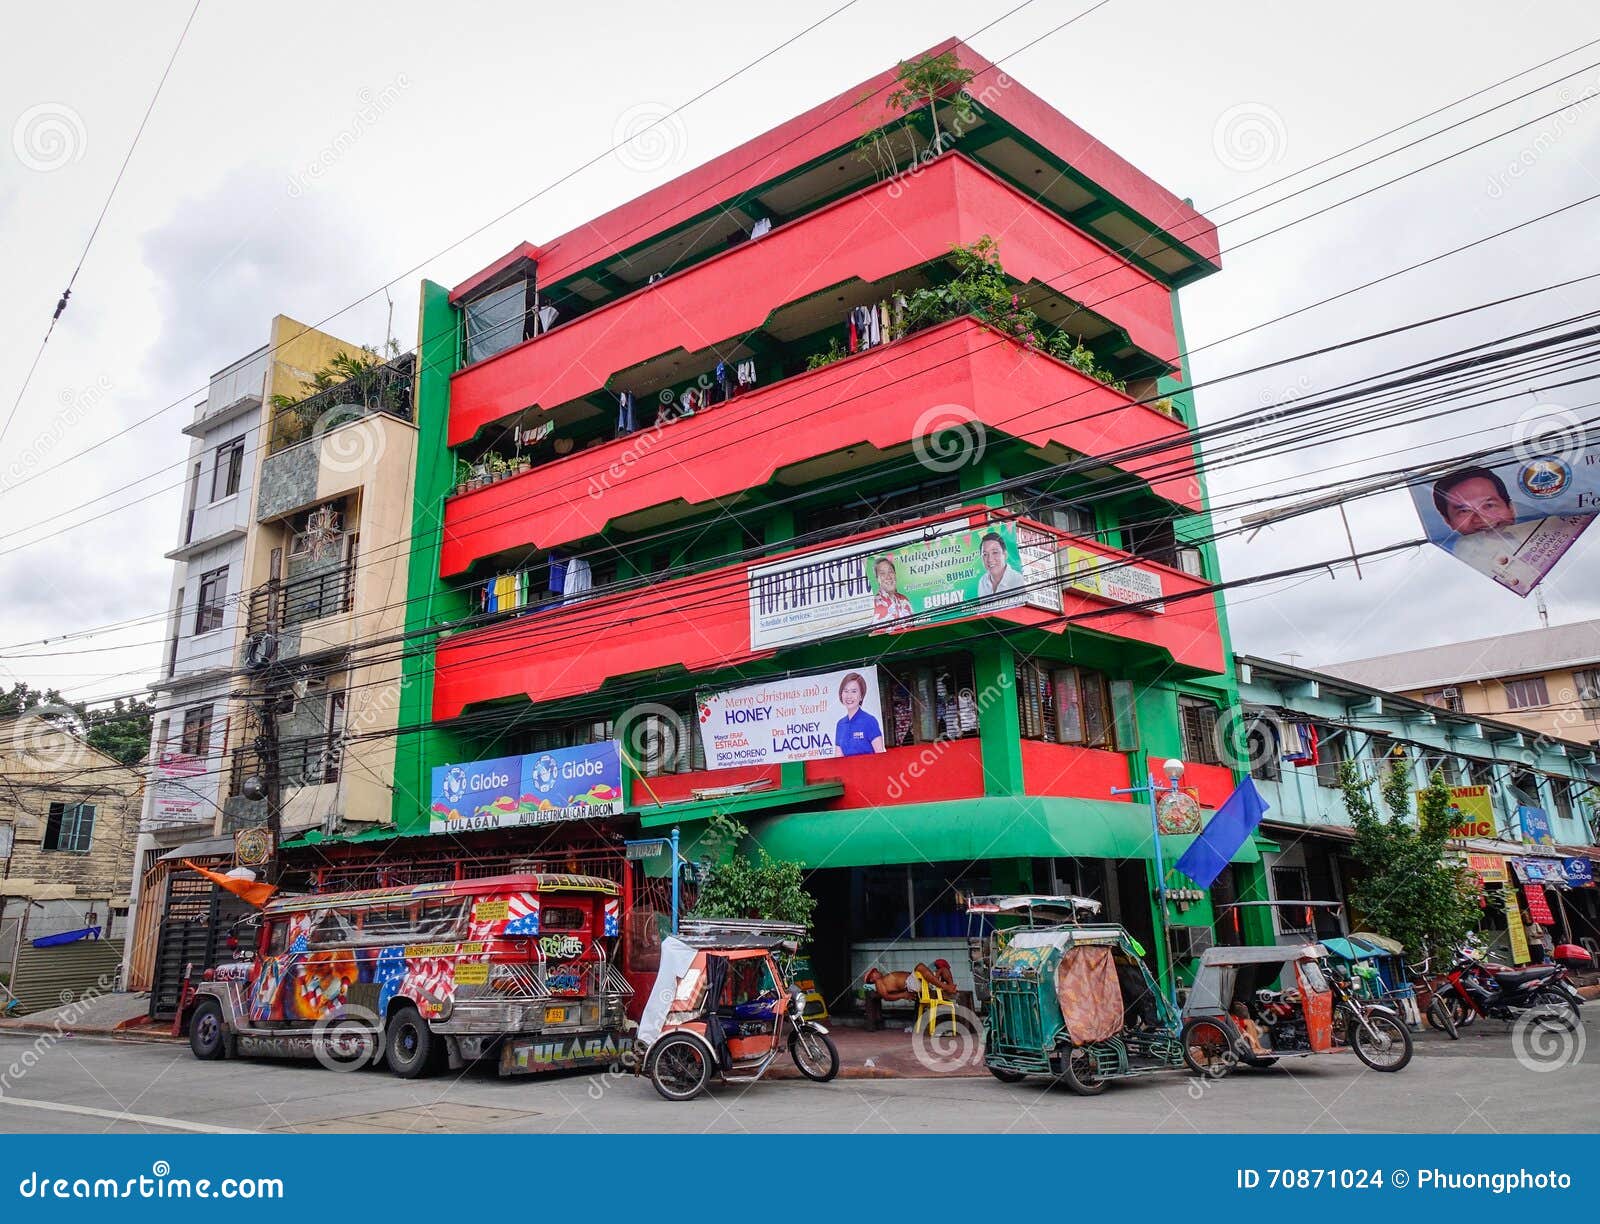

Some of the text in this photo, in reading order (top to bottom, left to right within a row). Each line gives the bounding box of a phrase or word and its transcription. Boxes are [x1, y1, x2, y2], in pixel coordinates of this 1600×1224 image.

[946, 568, 974, 582] BUHAY
[760, 573, 788, 615] HOPE
[791, 558, 843, 608] BAPTIST
[924, 590, 964, 609] BUHAY
[760, 618, 782, 628] Schedule
[725, 685, 829, 710] Merry Christmas and a
[725, 706, 772, 725] HONEY
[776, 707, 797, 718] New
[787, 722, 820, 735] HONEY
[715, 739, 749, 750] ESTRADA
[773, 734, 833, 753] LACUNA
[717, 748, 767, 761] ISKO MORENO
[808, 748, 834, 757] SERVICE
[562, 760, 604, 779] Globe
[470, 772, 509, 791] Globe
[1451, 787, 1486, 798] AMILY
[519, 803, 614, 824] AUTO ELECTRICAL CAR AIRCON
[444, 816, 500, 831] TULAGAN
[635, 844, 663, 857] TUAZON
